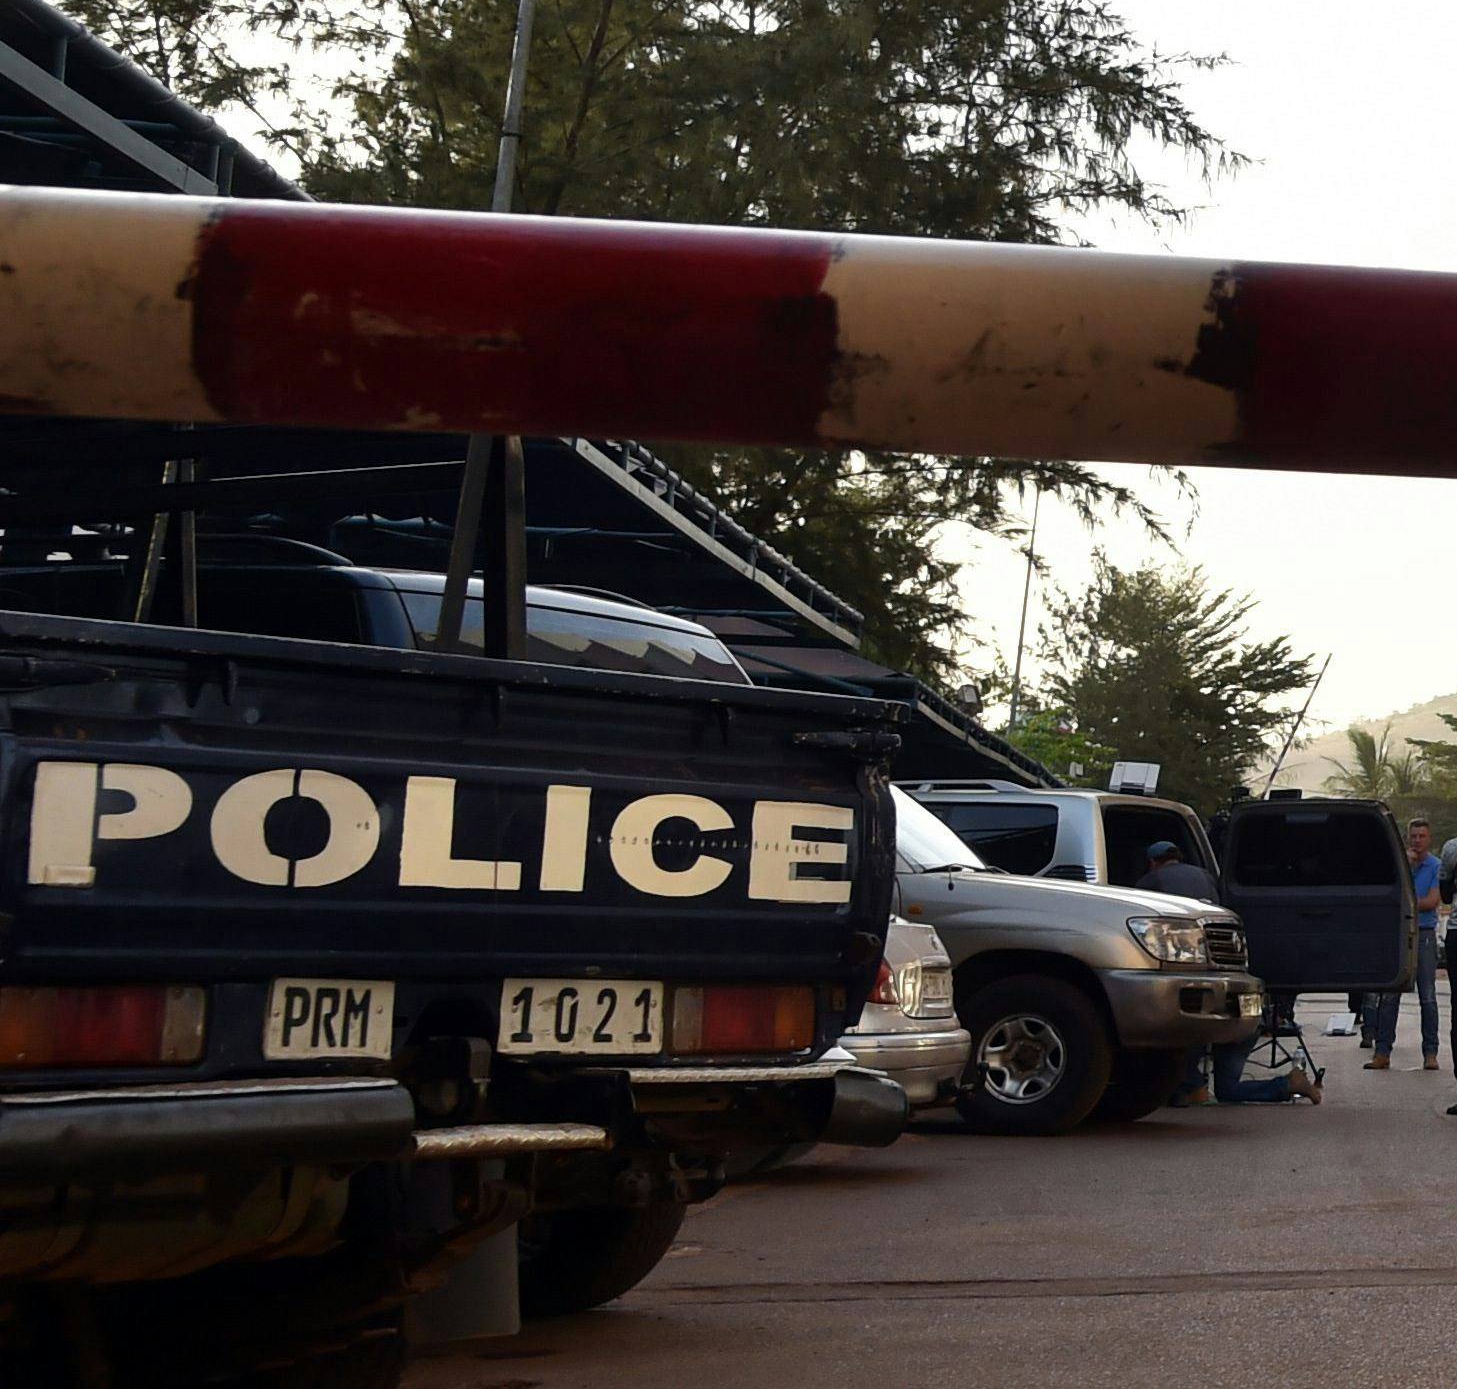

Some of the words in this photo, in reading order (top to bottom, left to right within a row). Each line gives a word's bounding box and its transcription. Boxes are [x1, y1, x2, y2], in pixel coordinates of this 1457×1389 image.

[27, 761, 854, 903] POLICE
[282, 986, 372, 1048] PRM
[510, 987, 652, 1043] 1021
